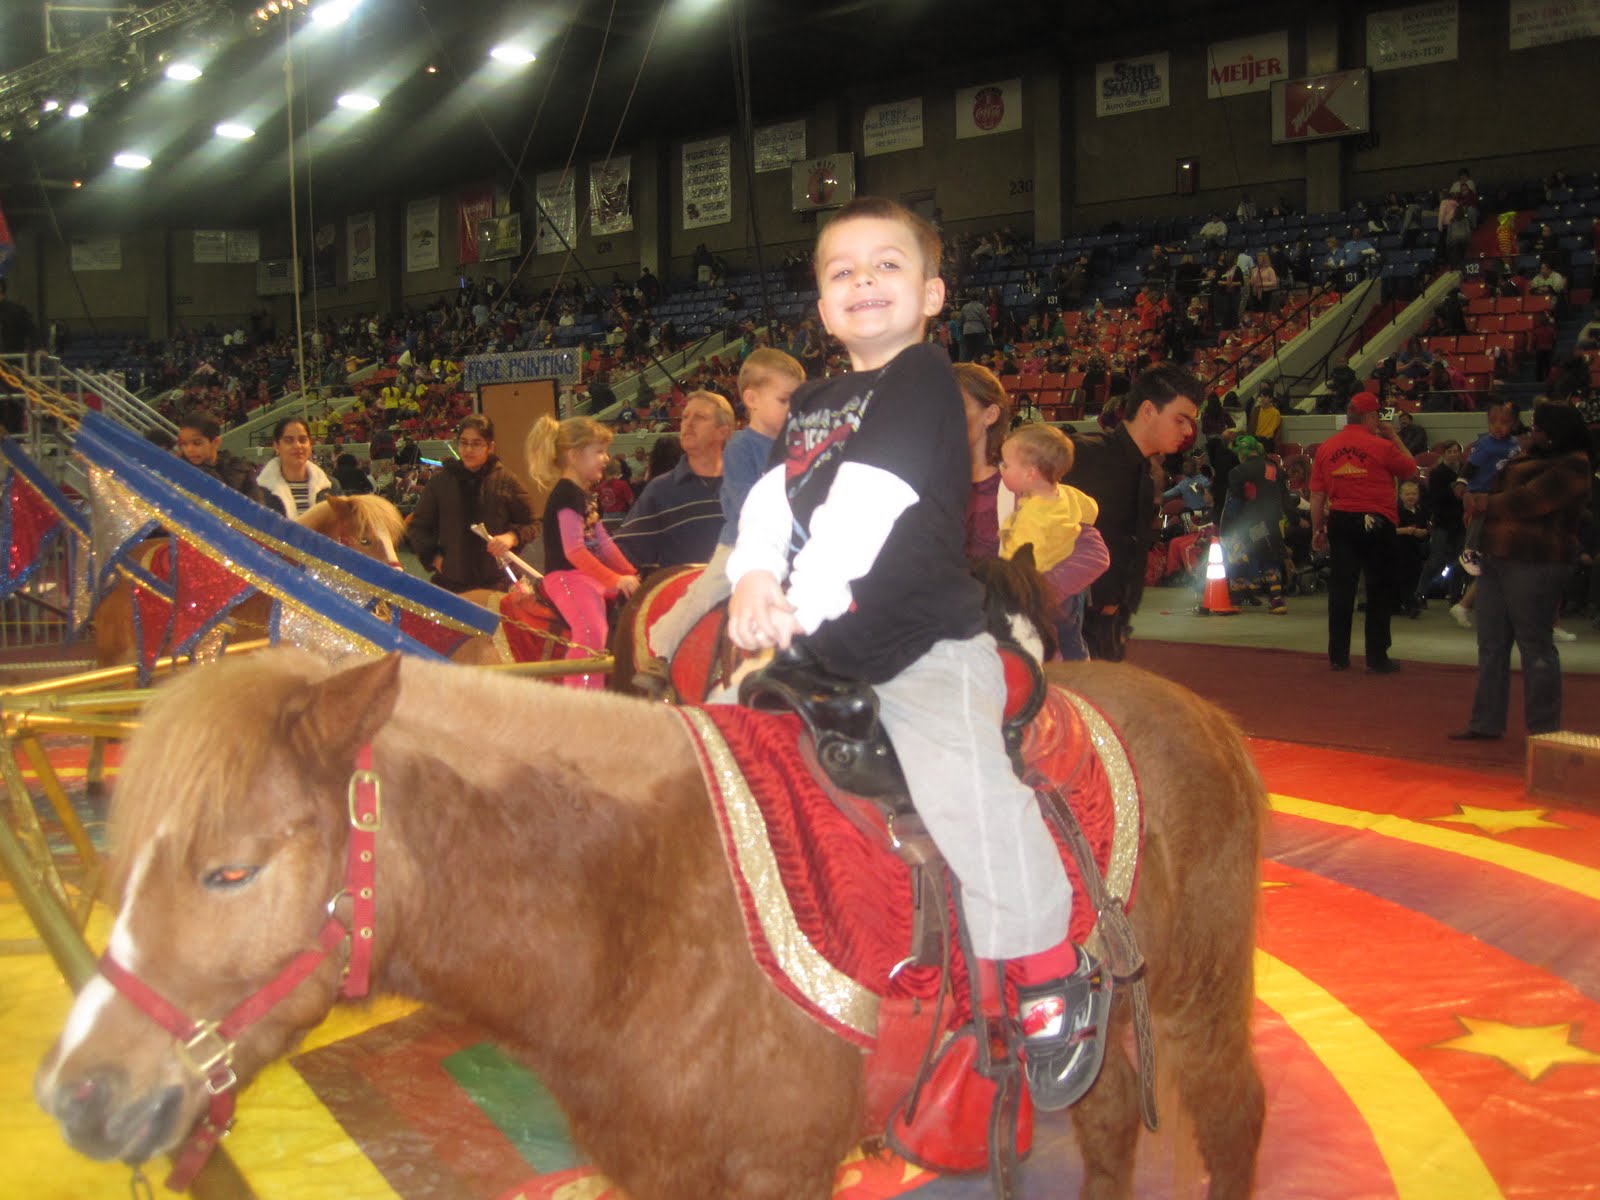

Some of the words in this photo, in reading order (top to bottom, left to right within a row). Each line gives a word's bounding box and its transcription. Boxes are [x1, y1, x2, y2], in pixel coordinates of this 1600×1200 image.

[1211, 54, 1281, 85] MEIJER
[1009, 179, 1033, 196] 230
[1465, 263, 1480, 273] 132
[1345, 272, 1357, 282] 131
[1047, 295, 1058, 304] 131
[467, 360, 503, 381] FACE
[509, 353, 576, 378] PAINTING
